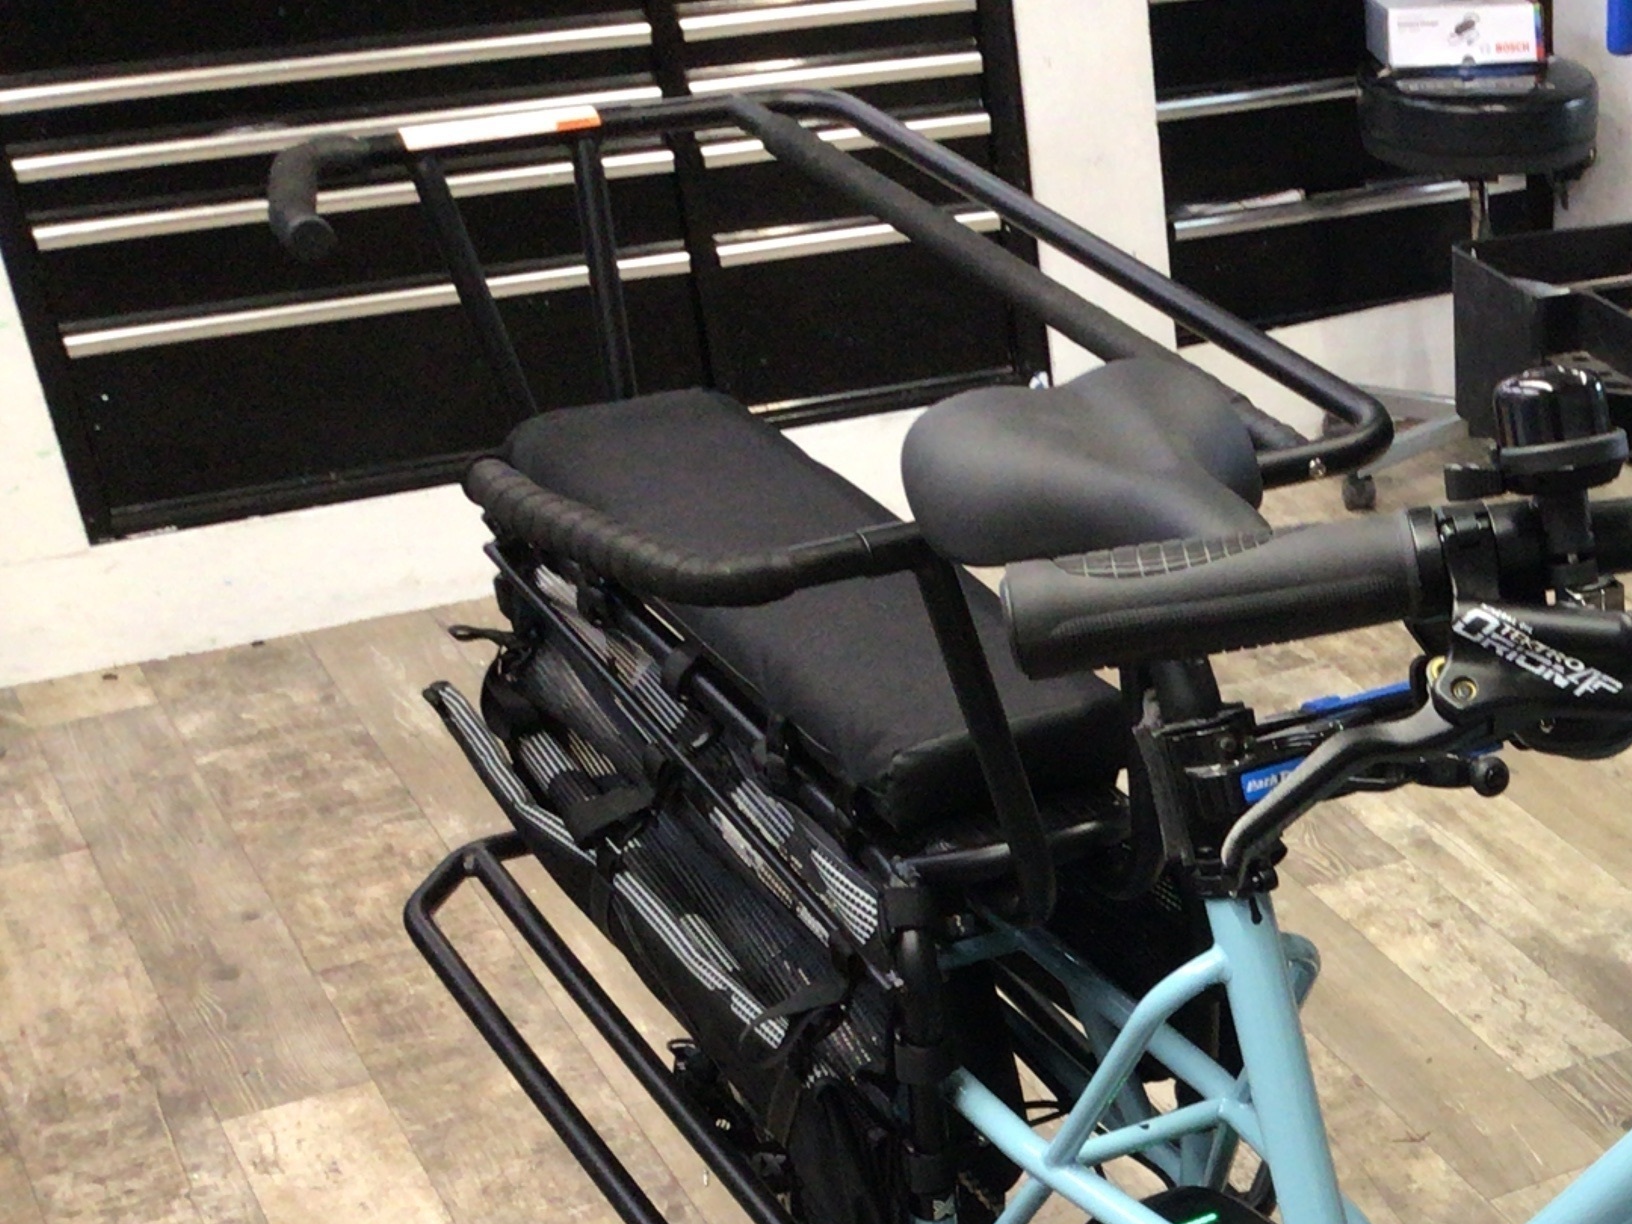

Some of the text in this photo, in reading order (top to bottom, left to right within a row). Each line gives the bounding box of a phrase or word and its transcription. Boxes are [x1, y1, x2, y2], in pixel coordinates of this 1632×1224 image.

[1495, 41, 1530, 54] BOSCH
[1452, 608, 1570, 690] ORION
[1500, 622, 1586, 672] TEKTRO
